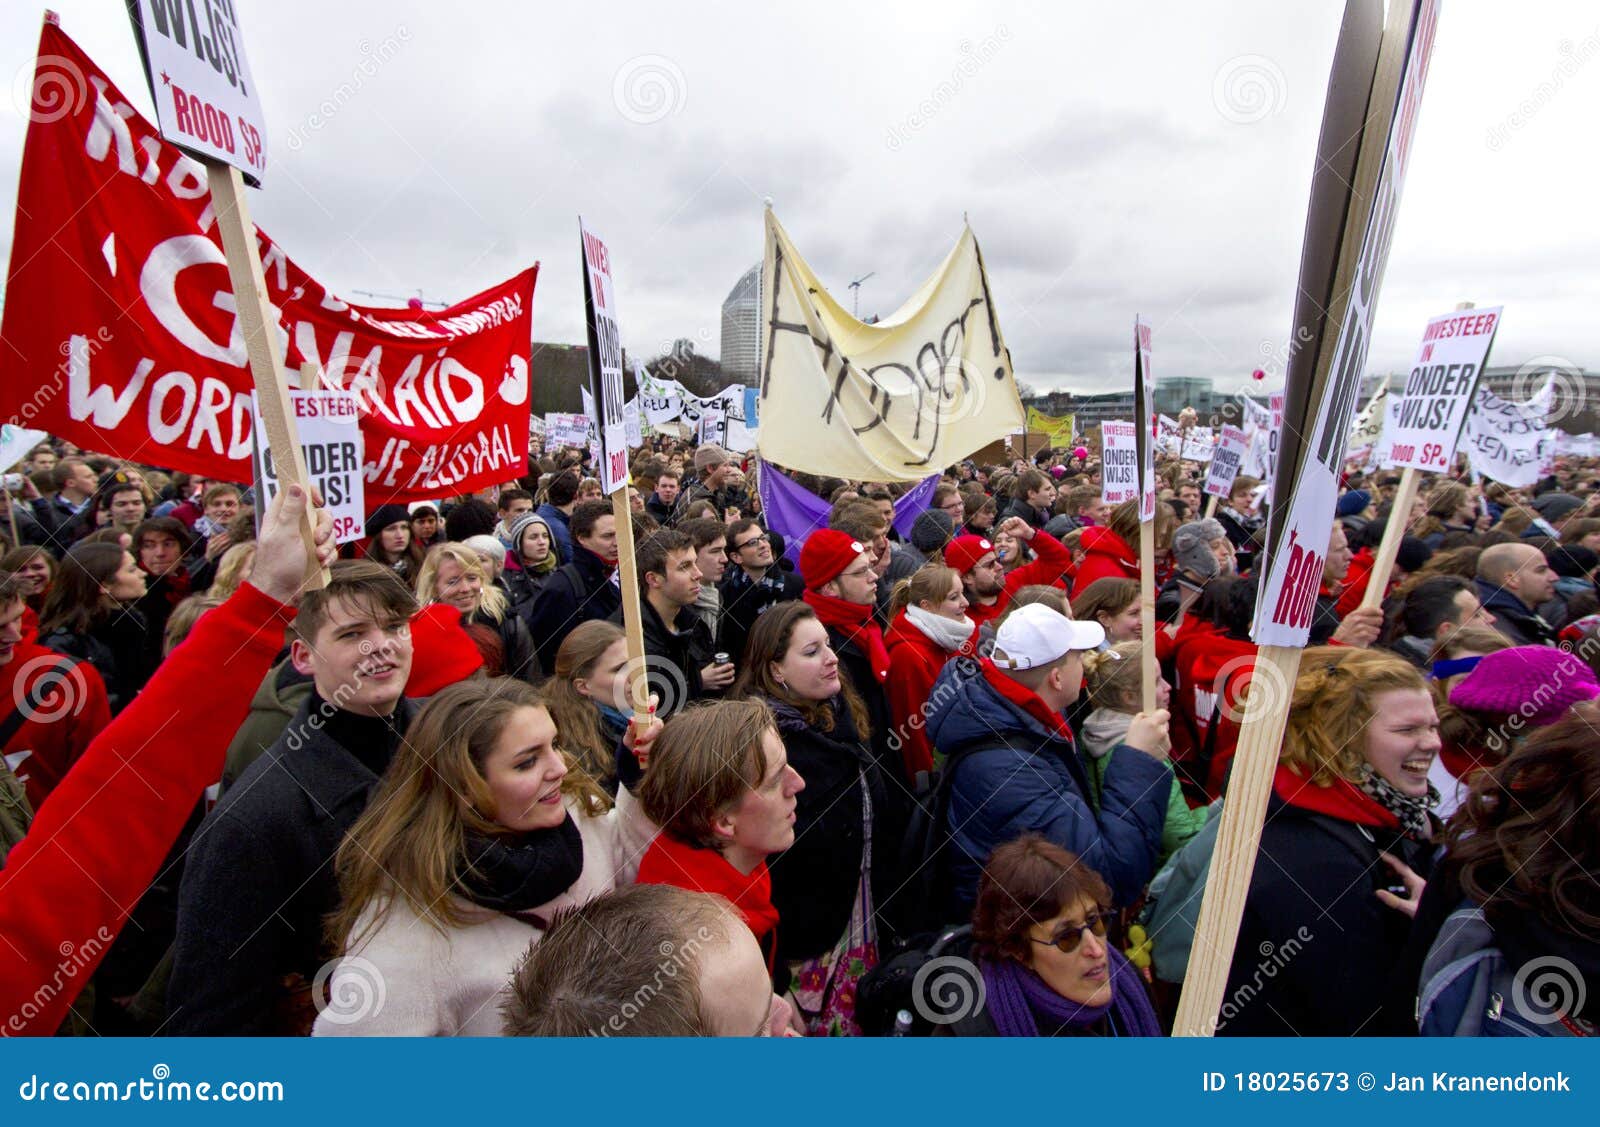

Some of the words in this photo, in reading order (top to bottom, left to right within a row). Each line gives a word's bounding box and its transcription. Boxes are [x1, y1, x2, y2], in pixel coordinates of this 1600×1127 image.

[172, 84, 235, 155] ROOD
[1423, 313, 1497, 342] INVESTEER
[1421, 344, 1435, 362] IN
[1406, 363, 1475, 396] ONDER
[280, 397, 356, 418] ESTEER
[1399, 398, 1456, 431] WIJS!
[1105, 449, 1136, 466] ONDER
[1105, 466, 1134, 483] WIJS!
